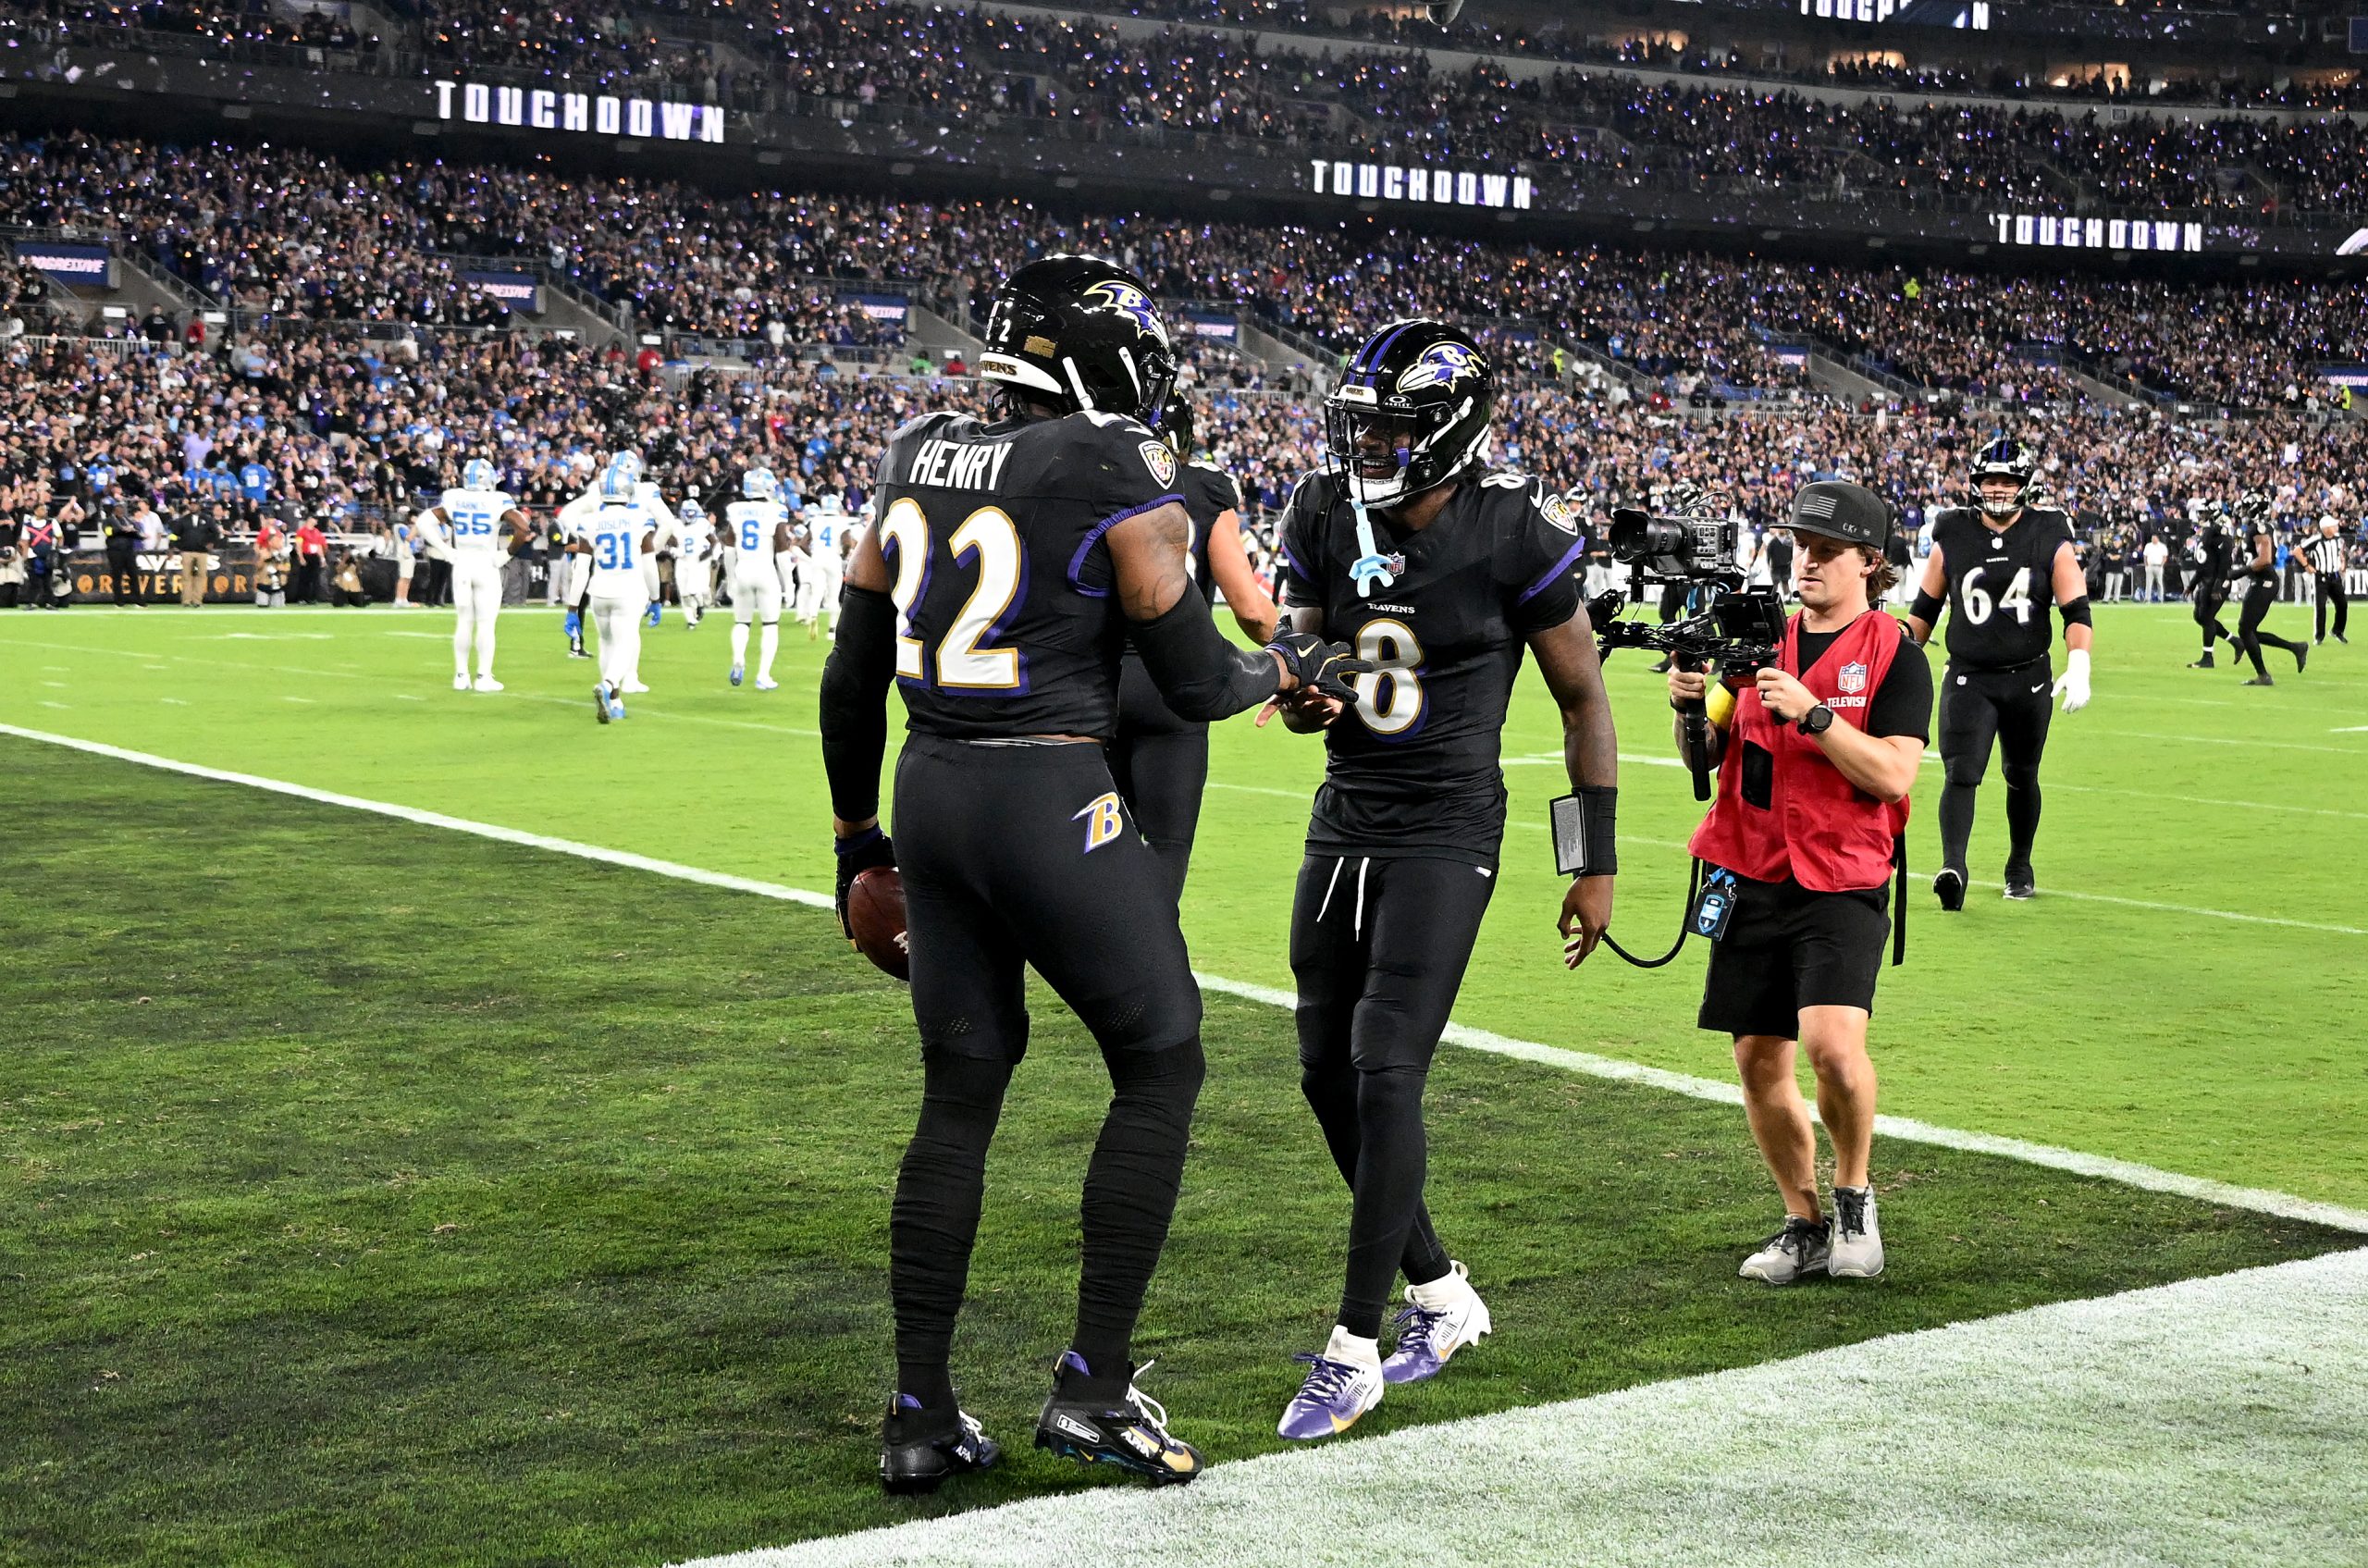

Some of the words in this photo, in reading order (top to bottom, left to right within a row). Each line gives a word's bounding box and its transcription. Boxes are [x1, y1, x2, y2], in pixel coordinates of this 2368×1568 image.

[435, 80, 724, 143] TOUCHDOWN
[1311, 160, 1532, 209] TOUCHDOWN
[1997, 214, 2202, 252] TOUCHDOWN
[908, 438, 1013, 491] HENRY
[452, 511, 492, 535] 55
[741, 519, 760, 550] 6
[820, 525, 832, 548] 4
[595, 531, 634, 570] 31
[880, 497, 1030, 698] 22
[1367, 602, 1416, 614] RAVENS
[1961, 567, 2032, 625] 64
[1353, 618, 1427, 738] 8
[1842, 675, 1862, 687] NFL
